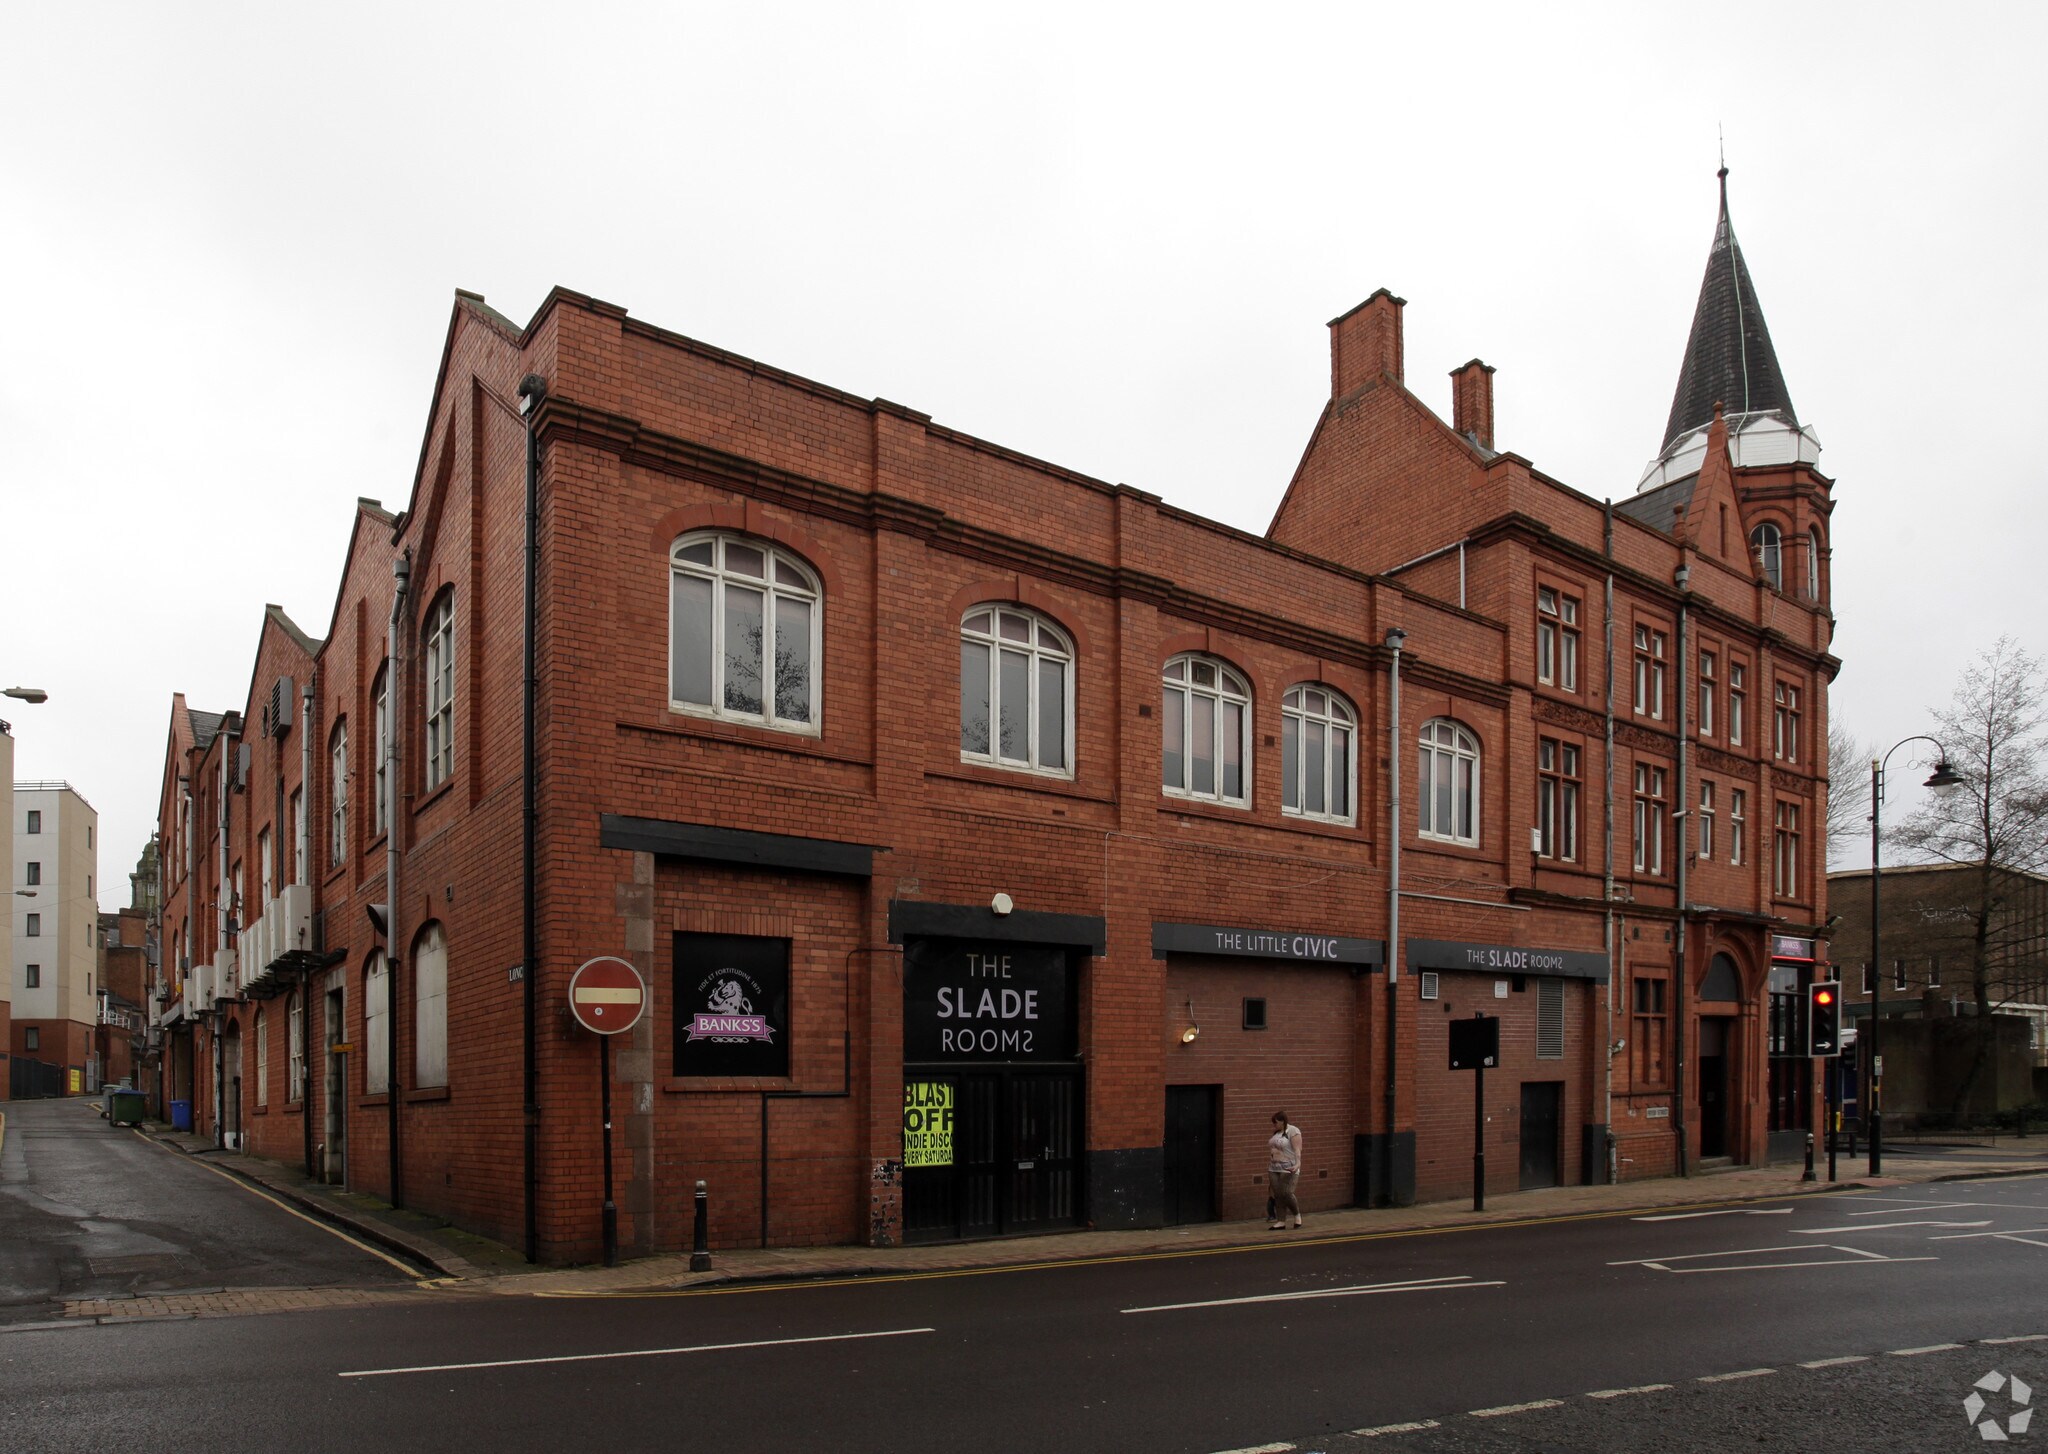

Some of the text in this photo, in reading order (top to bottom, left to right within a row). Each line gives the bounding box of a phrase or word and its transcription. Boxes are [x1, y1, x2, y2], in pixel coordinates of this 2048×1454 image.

[1215, 932, 1338, 959] THE LITTLE CIVIC
[966, 953, 1012, 979] THE
[1466, 949, 1486, 964] THE
[1488, 949, 1528, 969] SLADE
[936, 985, 1039, 1020] SLADE
[699, 1018, 761, 1032] BANKS'S
[903, 1082, 954, 1107] BLAST
[904, 1108, 954, 1132] OFF
[903, 1149, 953, 1165] EVERY SATURDA
